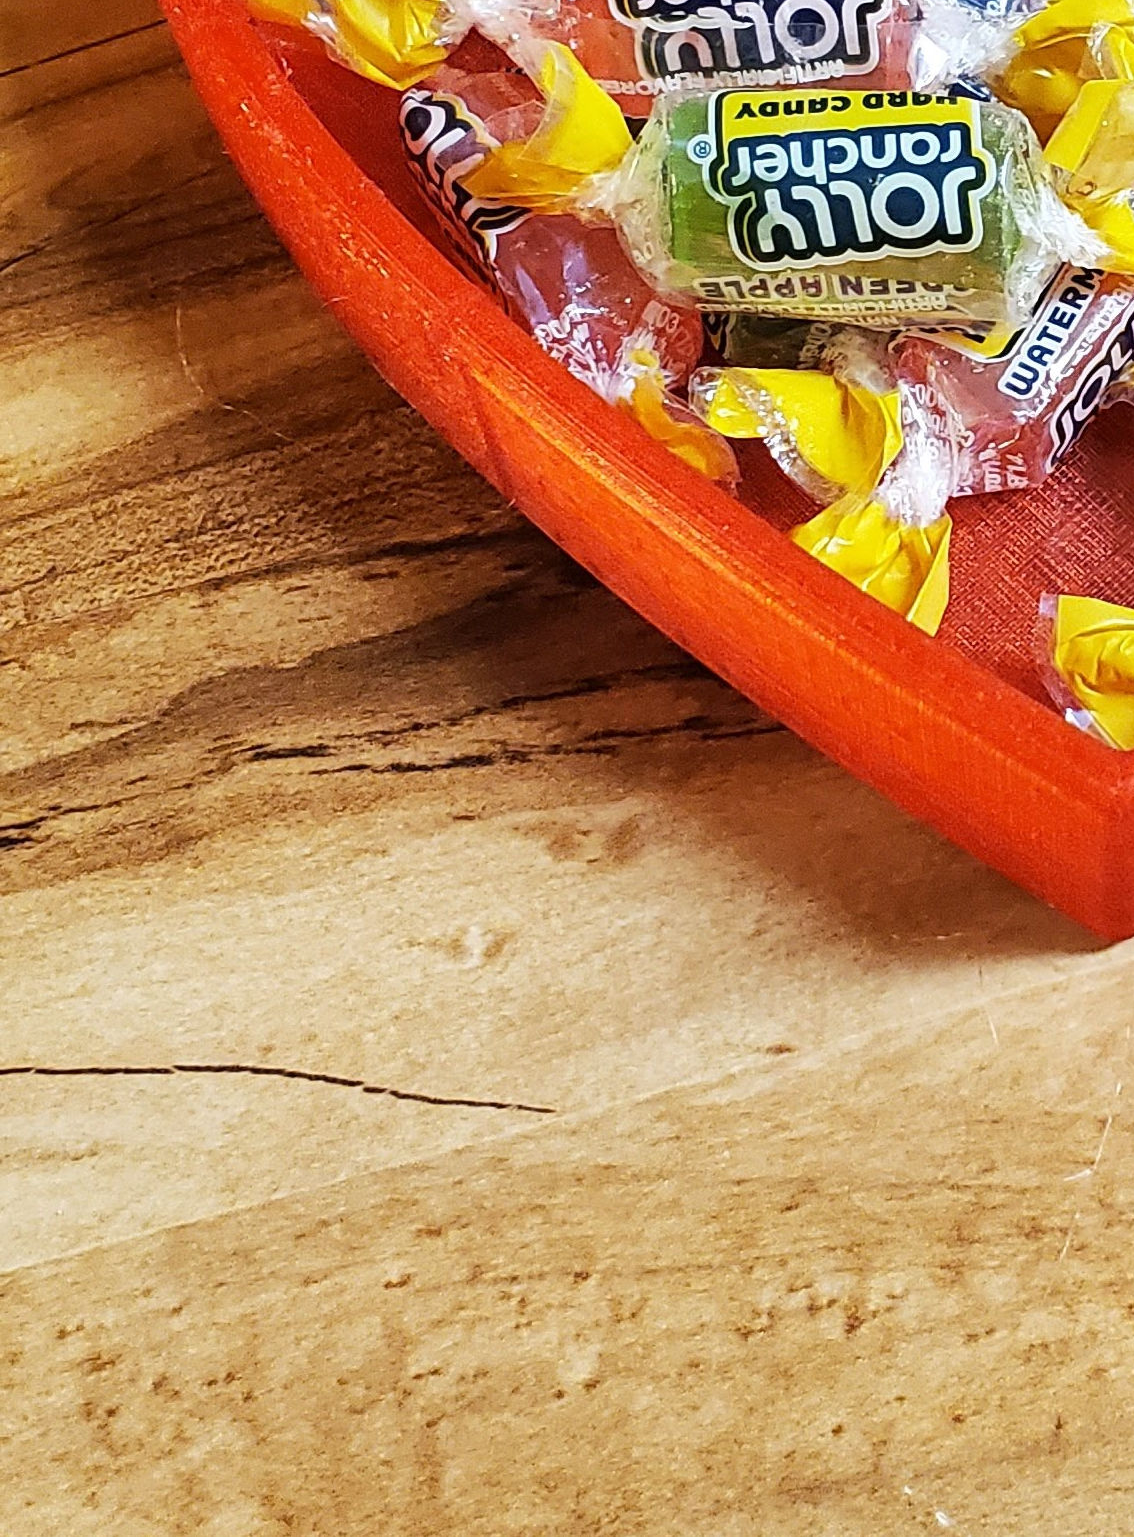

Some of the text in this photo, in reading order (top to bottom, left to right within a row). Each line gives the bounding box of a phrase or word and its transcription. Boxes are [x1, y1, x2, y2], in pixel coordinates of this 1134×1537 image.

[732, 94, 851, 118] CANDY
[730, 129, 961, 187] rancher
[756, 166, 975, 252] JOLLY
[698, 274, 820, 297] APPLE
[1004, 265, 1104, 396] WATERM
